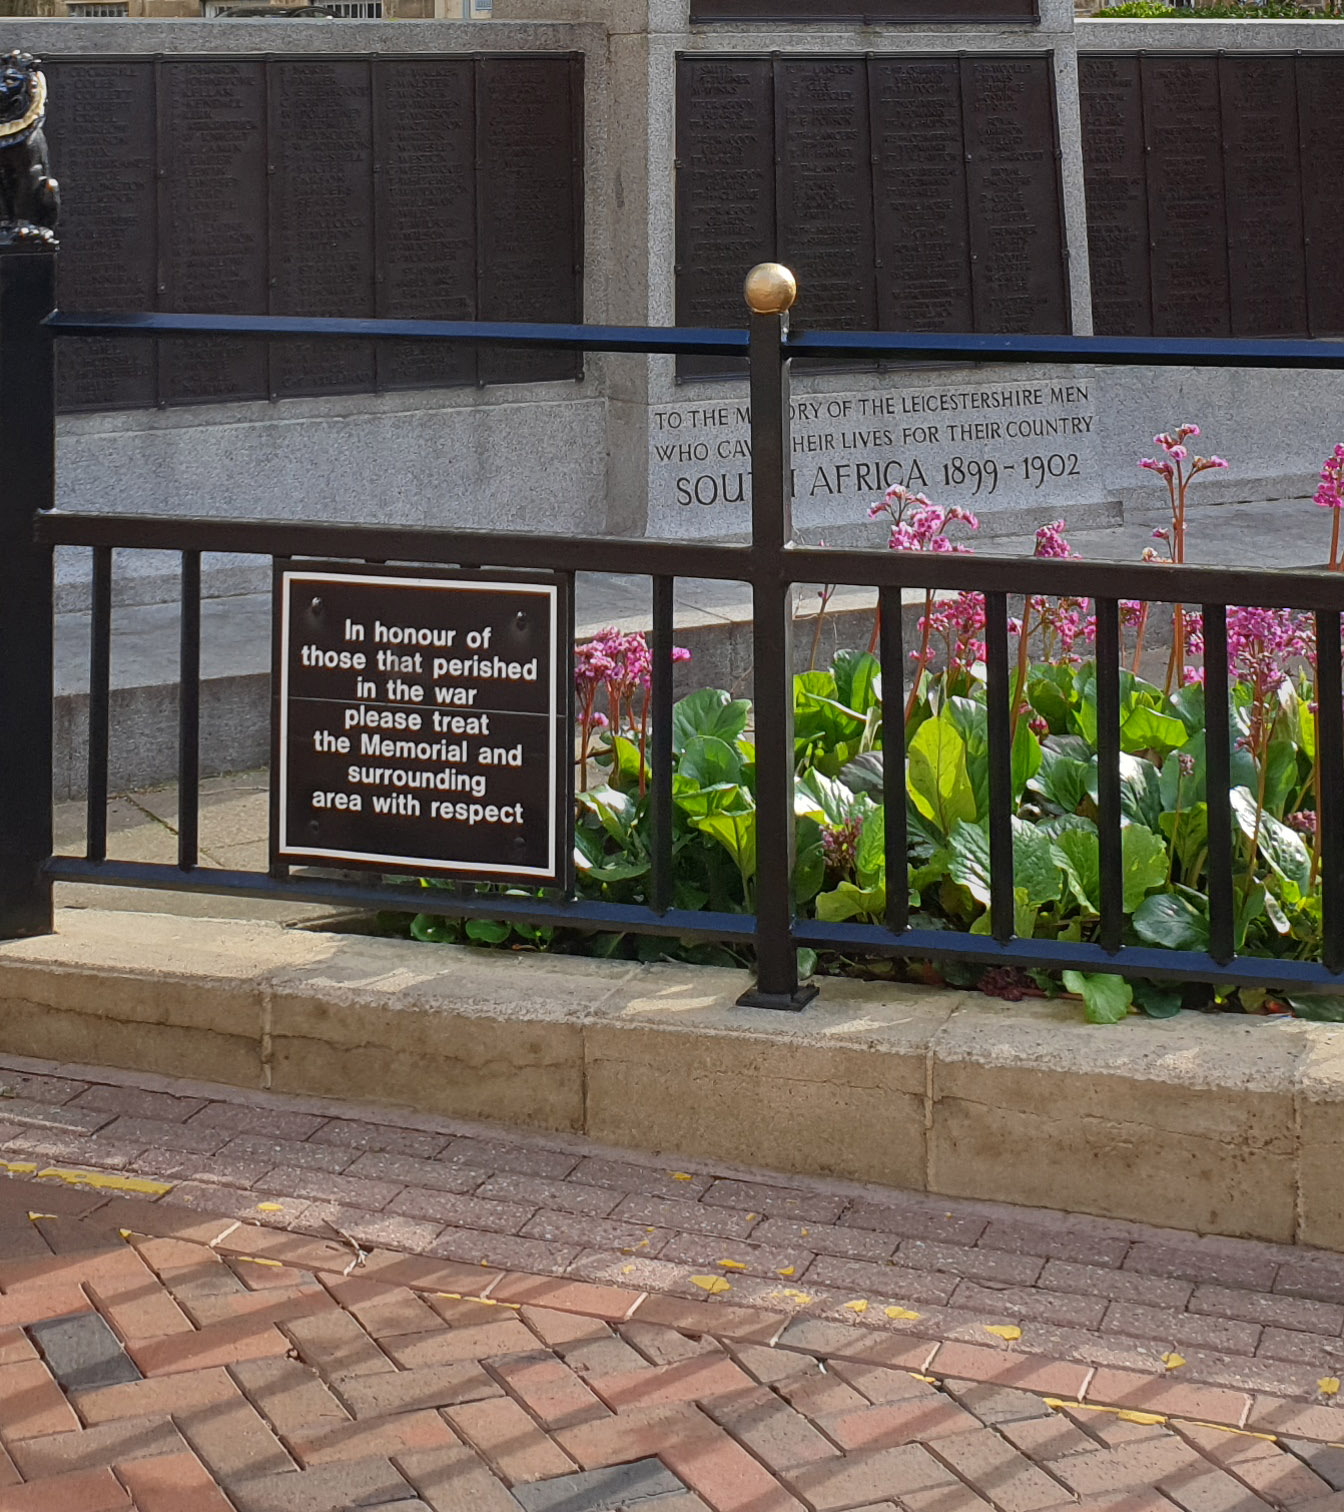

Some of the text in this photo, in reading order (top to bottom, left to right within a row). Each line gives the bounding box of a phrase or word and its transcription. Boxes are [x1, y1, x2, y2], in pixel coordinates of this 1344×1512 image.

[654, 385, 1090, 431] TO THE MRY OF THE LEICESTERSHIRE MEN
[654, 442, 710, 463] WHO
[792, 432, 837, 454] HEIR
[840, 429, 894, 450] LIVES
[902, 425, 941, 445] FOR
[945, 421, 1003, 442] THEIR
[1005, 415, 1095, 438] COUNTRY
[675, 471, 797, 507] SOU
[808, 457, 930, 497] AFRICA
[345, 618, 492, 650] In honour of
[301, 644, 538, 681] those that perished
[357, 676, 478, 705] in the war
[345, 704, 490, 735] please treat
[313, 730, 522, 766] the Memorial and
[348, 765, 486, 798] surrounding
[312, 791, 524, 825] area with respect
